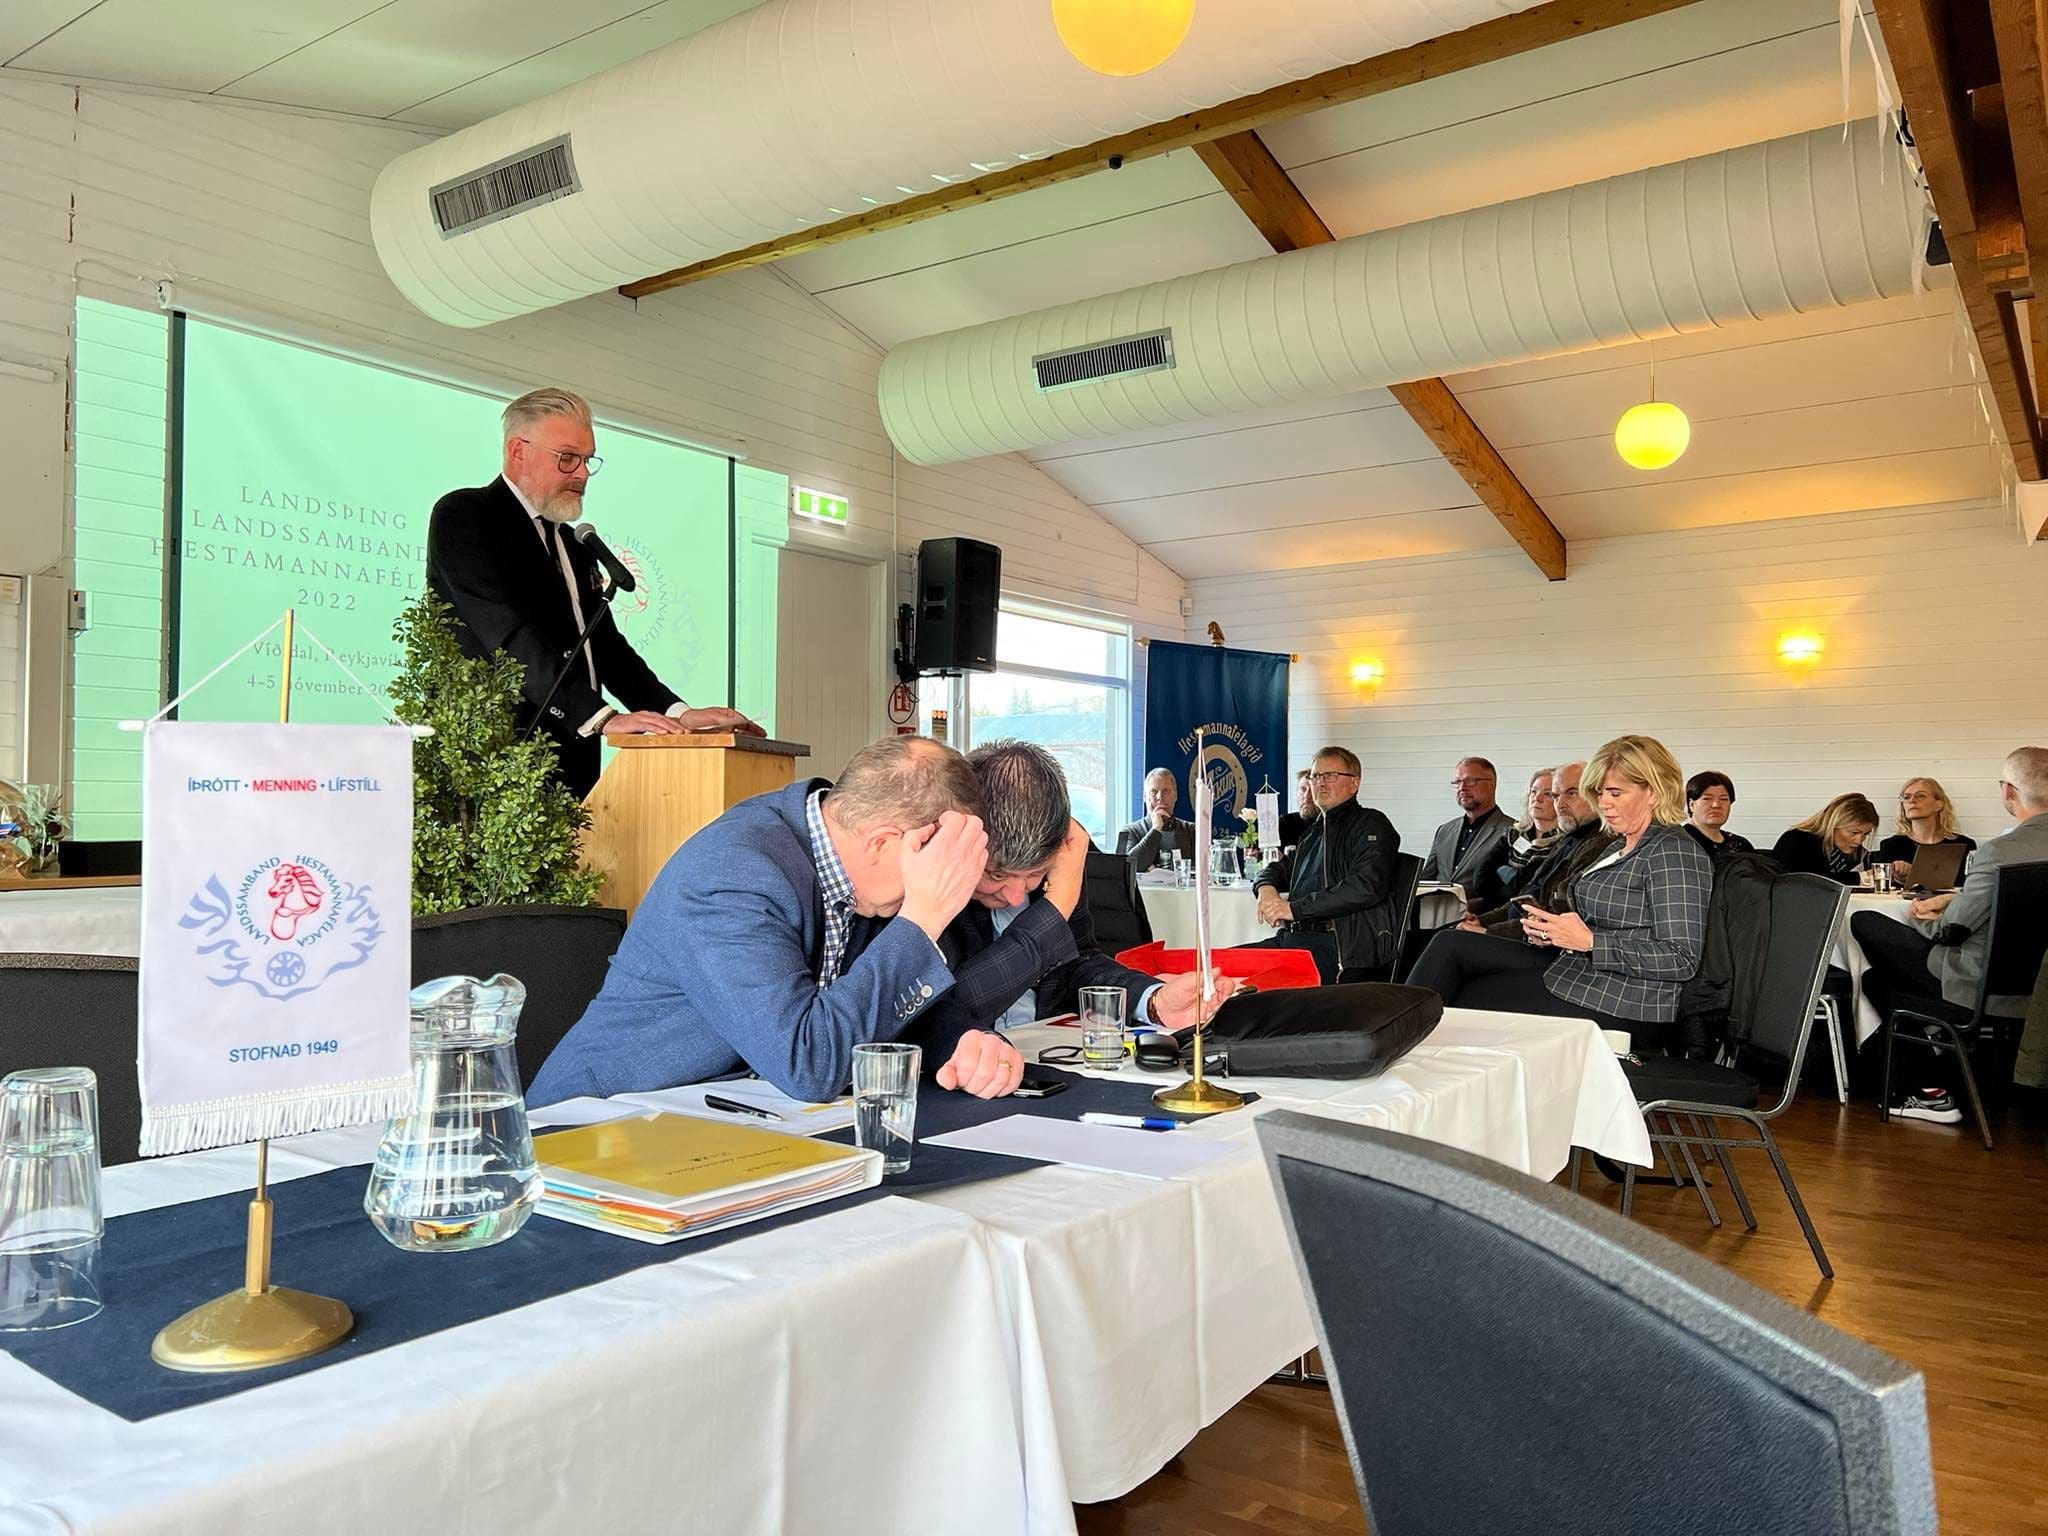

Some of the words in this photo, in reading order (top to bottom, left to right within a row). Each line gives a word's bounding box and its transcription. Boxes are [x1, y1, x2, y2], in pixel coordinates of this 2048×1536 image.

[240, 485, 408, 529] LANDSÞING
[151, 537, 426, 590] HESTAMANNAFÉL
[298, 588, 356, 611] 2022
[253, 641, 318, 662] Víðdal,
[291, 676, 364, 696] óvember
[1178, 722, 1262, 763] Hesmannafélagið
[188, 776, 240, 792] ÍÞRÓTT
[252, 779, 317, 792] MENNING
[328, 777, 382, 792] LÍFSTÍLL
[236, 856, 281, 946] LANDSSAMBAND
[229, 1043, 301, 1063] STOFNAÐ
[306, 1040, 338, 1055] 1949
